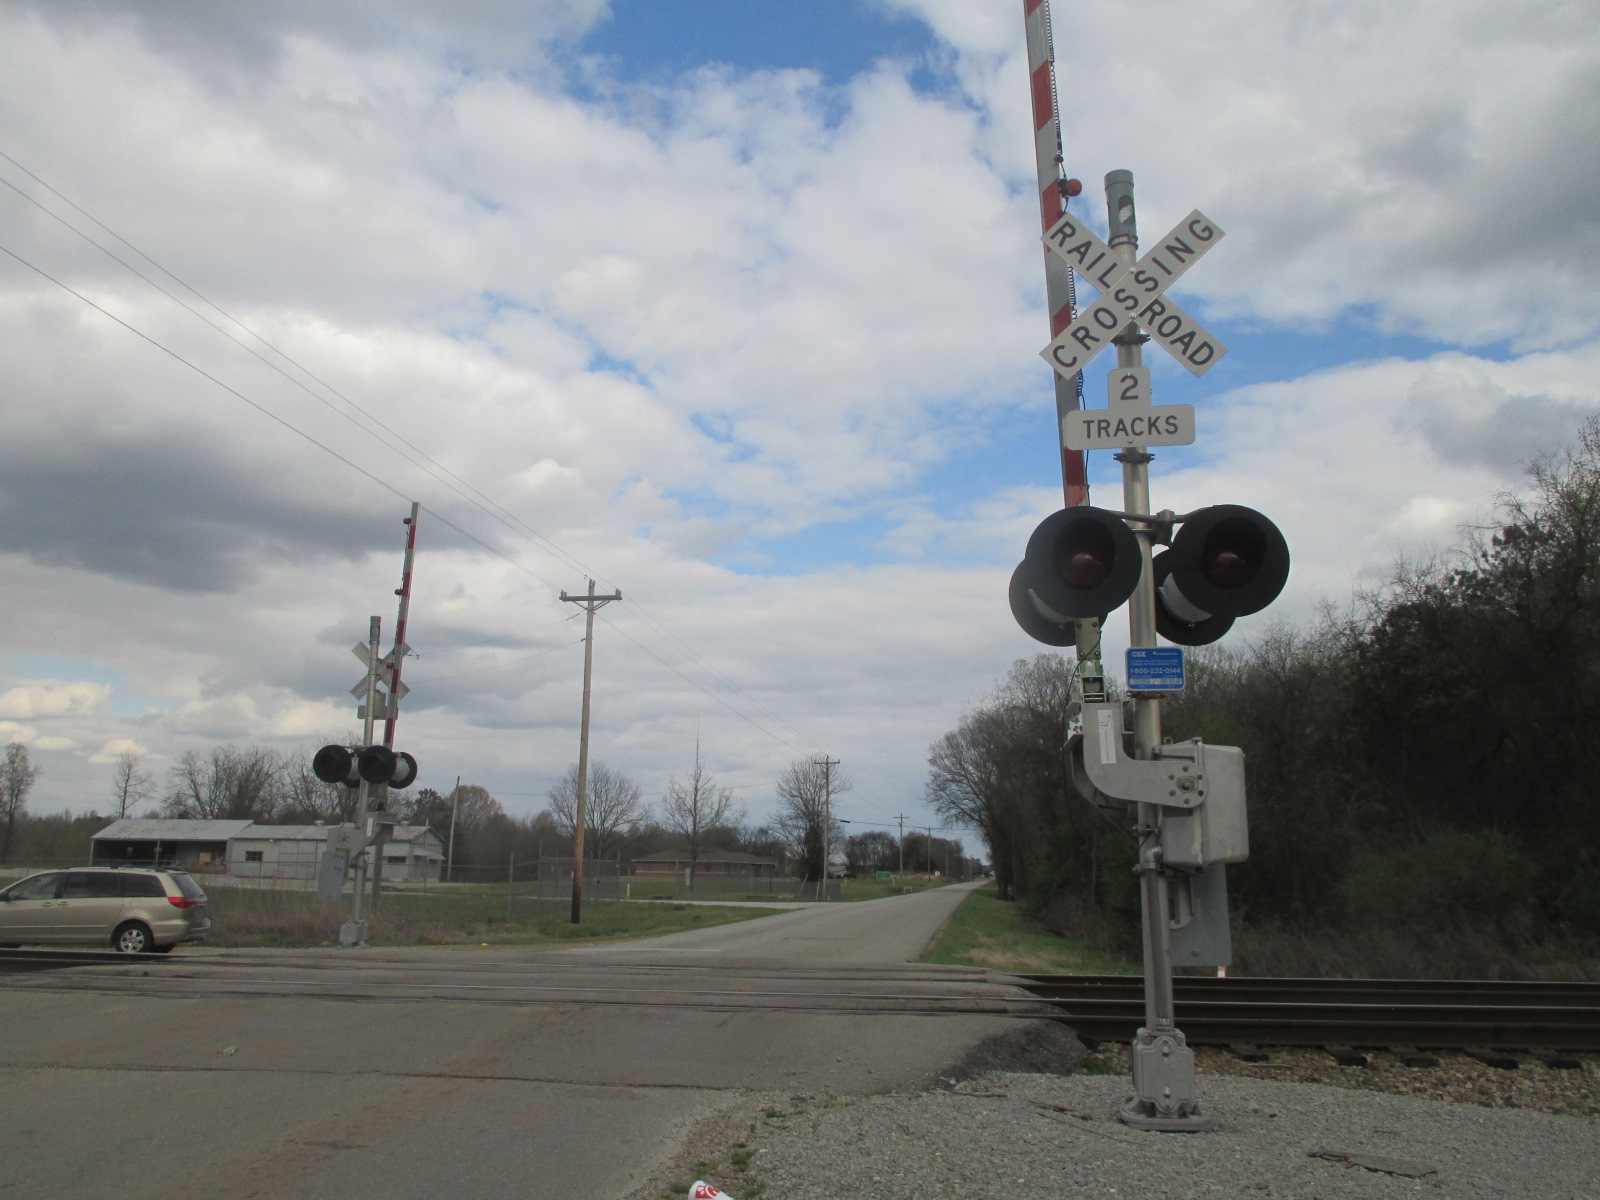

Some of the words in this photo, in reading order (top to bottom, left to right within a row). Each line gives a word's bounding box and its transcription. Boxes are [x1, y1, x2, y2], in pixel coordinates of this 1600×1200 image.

[1052, 219, 1214, 368] CROSSING
[1120, 375, 1139, 401] 2
[1082, 414, 1179, 439] TRACKS
